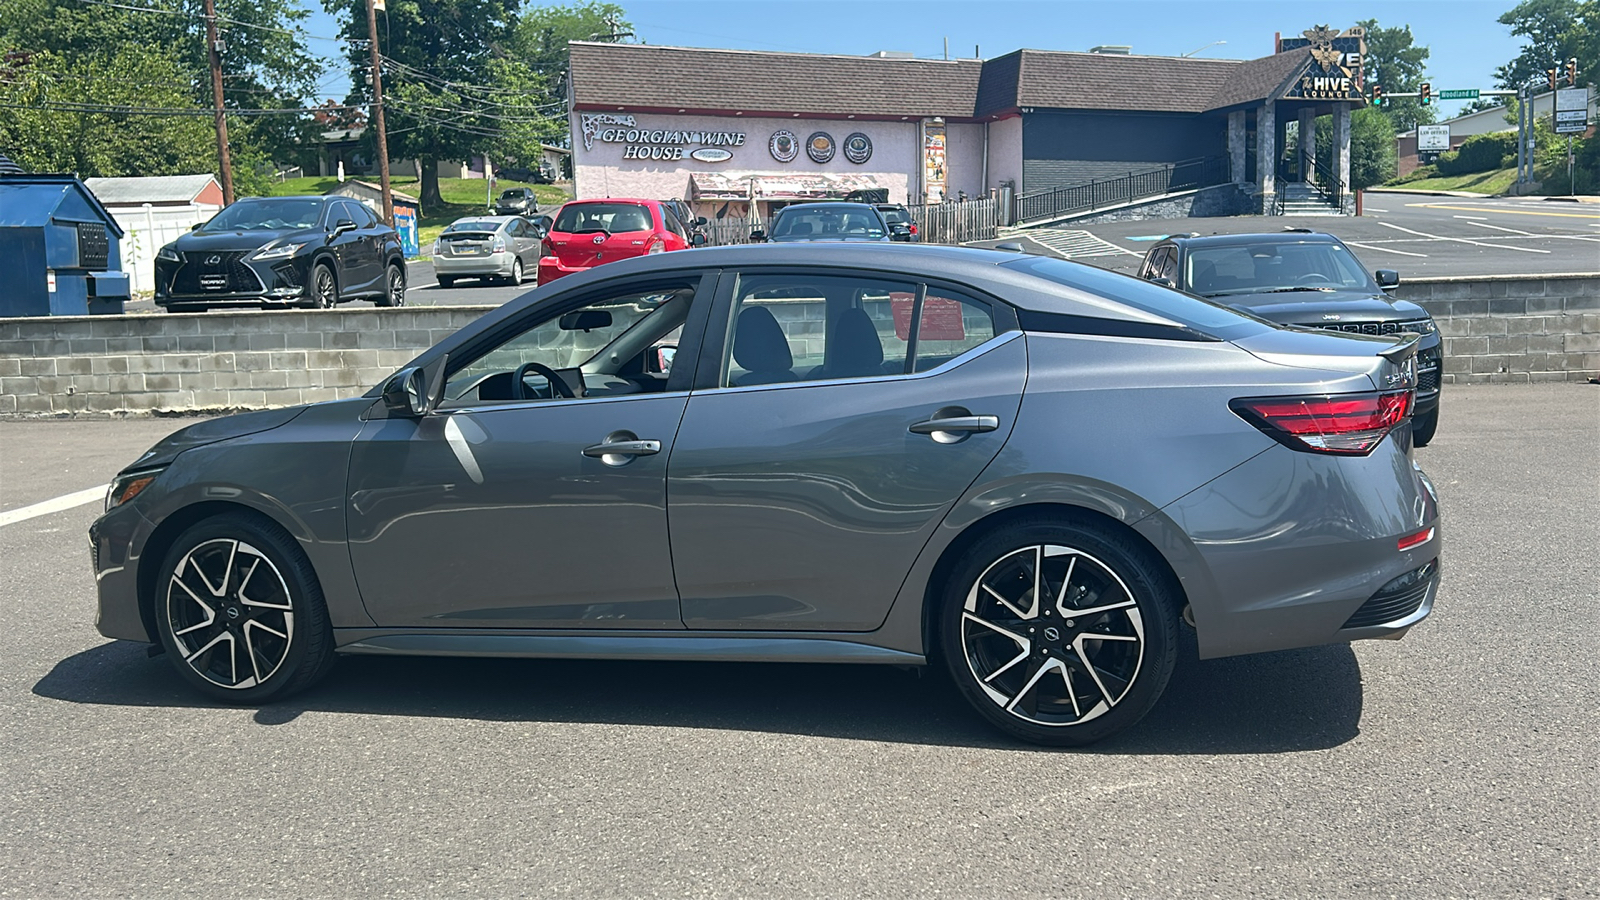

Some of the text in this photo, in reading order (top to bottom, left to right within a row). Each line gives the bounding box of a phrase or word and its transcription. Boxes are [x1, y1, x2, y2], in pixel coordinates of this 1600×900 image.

[1314, 77, 1350, 91] HIVE
[602, 129, 746, 146] GEORGIAN WINE
[623, 145, 683, 160] HOUSE
